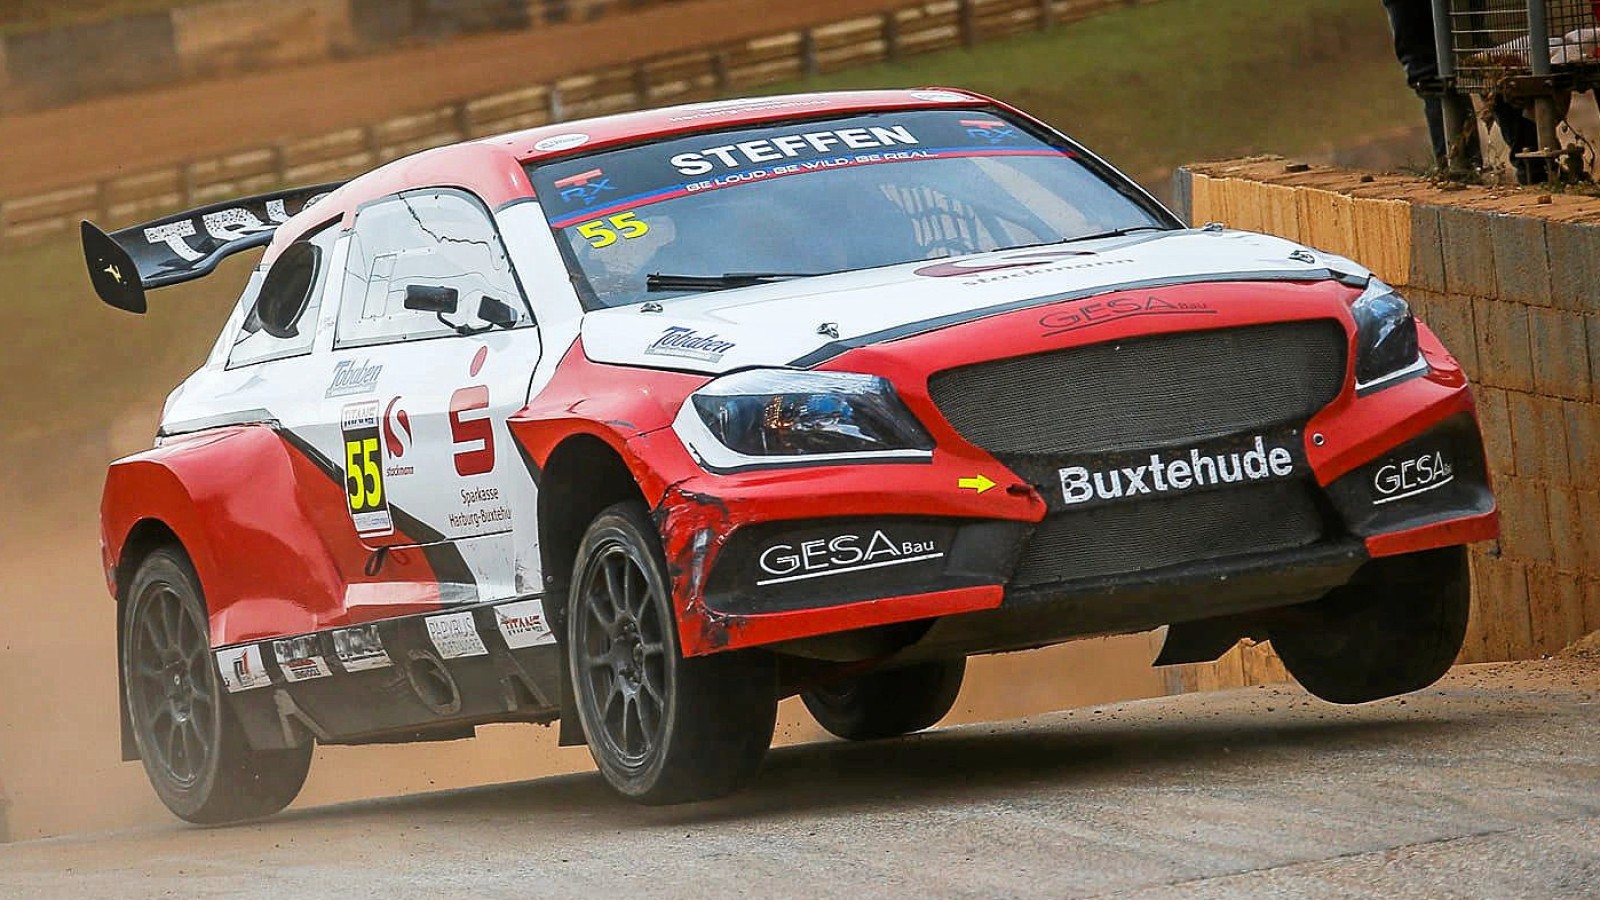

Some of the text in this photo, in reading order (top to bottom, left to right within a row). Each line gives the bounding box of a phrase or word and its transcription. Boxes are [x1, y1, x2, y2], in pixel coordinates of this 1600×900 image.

[670, 125, 919, 175] STEFFEN
[686, 181, 712, 191] BE
[715, 171, 771, 185] LOUD.
[774, 165, 799, 175] BE
[855, 154, 880, 163] BE
[576, 211, 650, 249] 55
[962, 259, 1134, 286] stockmann
[1038, 296, 1178, 328] GESA
[346, 438, 381, 510] 55
[1058, 436, 1293, 504] Buxtehude
[1375, 451, 1444, 494] GESA
[460, 487, 499, 507] Sparkasse
[759, 530, 935, 575] GESA Bau
